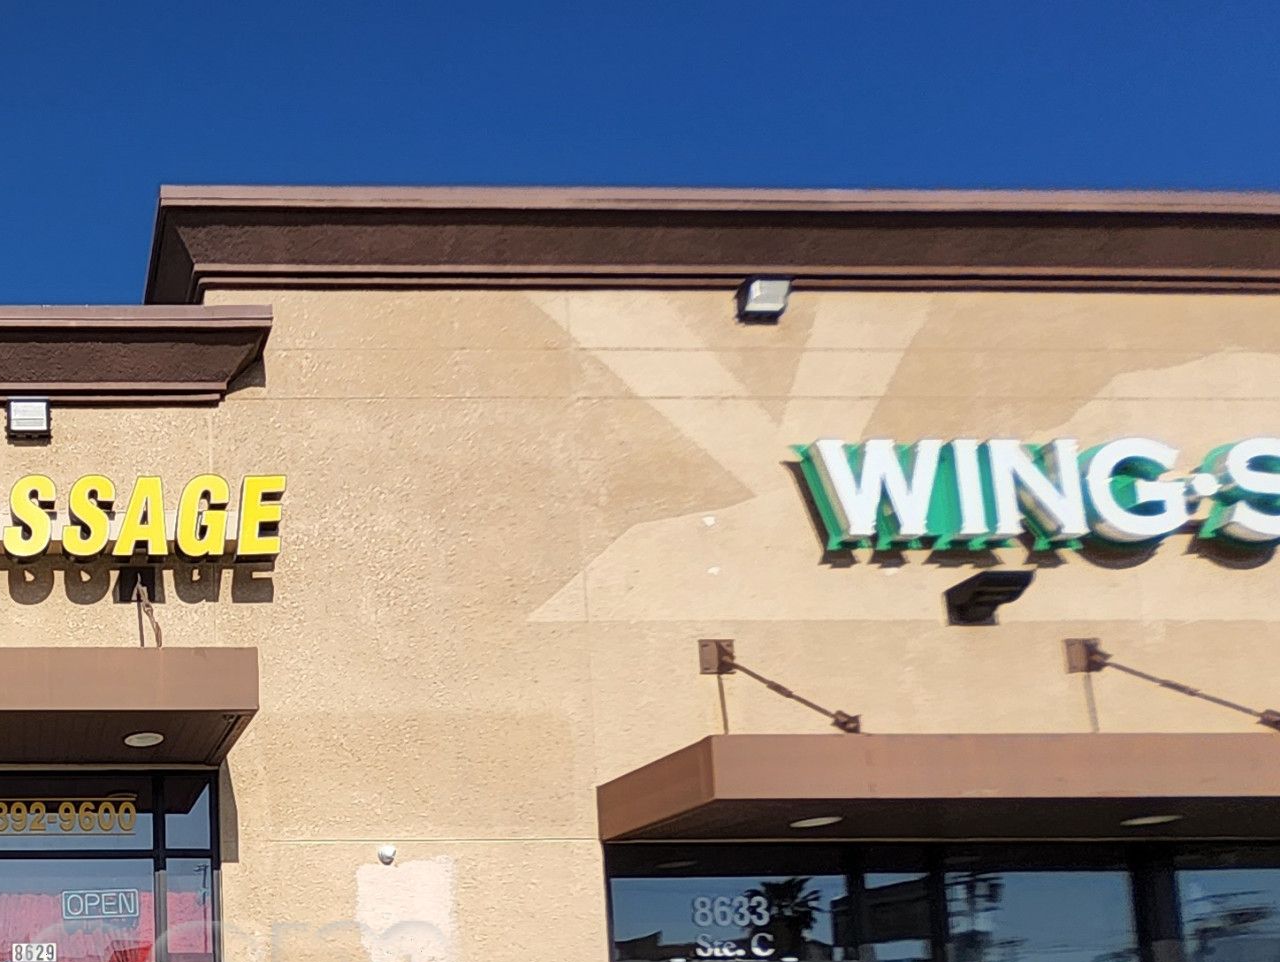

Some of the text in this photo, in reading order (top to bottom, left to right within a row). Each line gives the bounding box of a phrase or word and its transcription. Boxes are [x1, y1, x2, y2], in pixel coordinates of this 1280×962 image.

[67, 892, 135, 916] OPEN
[694, 896, 770, 926] 8633
[15, 944, 55, 961] 8629
[695, 932, 775, 957] Ste. C
